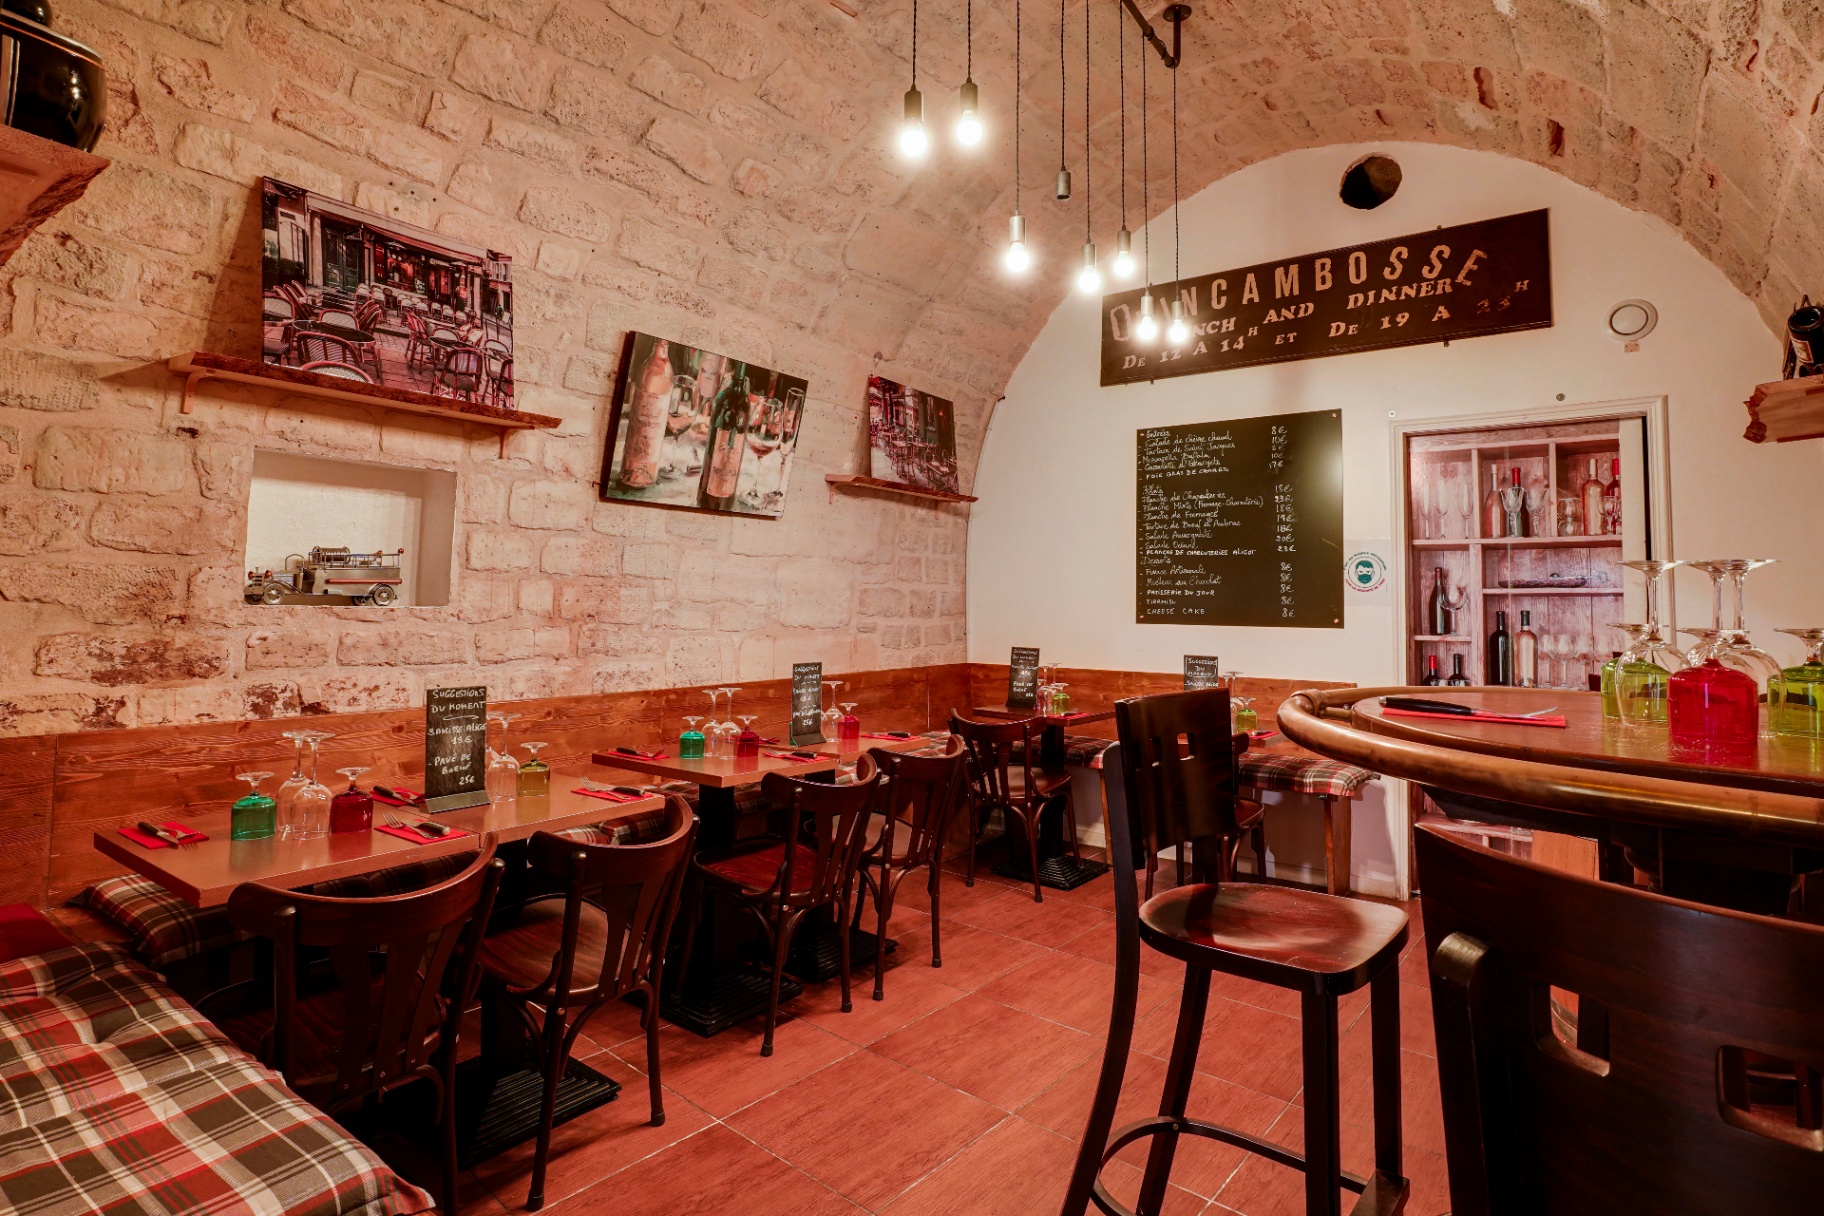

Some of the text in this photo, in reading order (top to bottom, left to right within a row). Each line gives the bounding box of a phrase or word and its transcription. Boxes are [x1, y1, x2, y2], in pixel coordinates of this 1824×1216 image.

[1110, 245, 1487, 341] QINCAMBOSSE
[1263, 302, 1315, 324] AND
[1347, 278, 1453, 309] DINNER
[1159, 349, 1181, 363] 12
[1193, 341, 1208, 355] A
[1380, 312, 1409, 329] 19
[1432, 305, 1450, 321] A
[1182, 607, 1205, 615] CAKE
[431, 700, 487, 713] DU MOMENT
